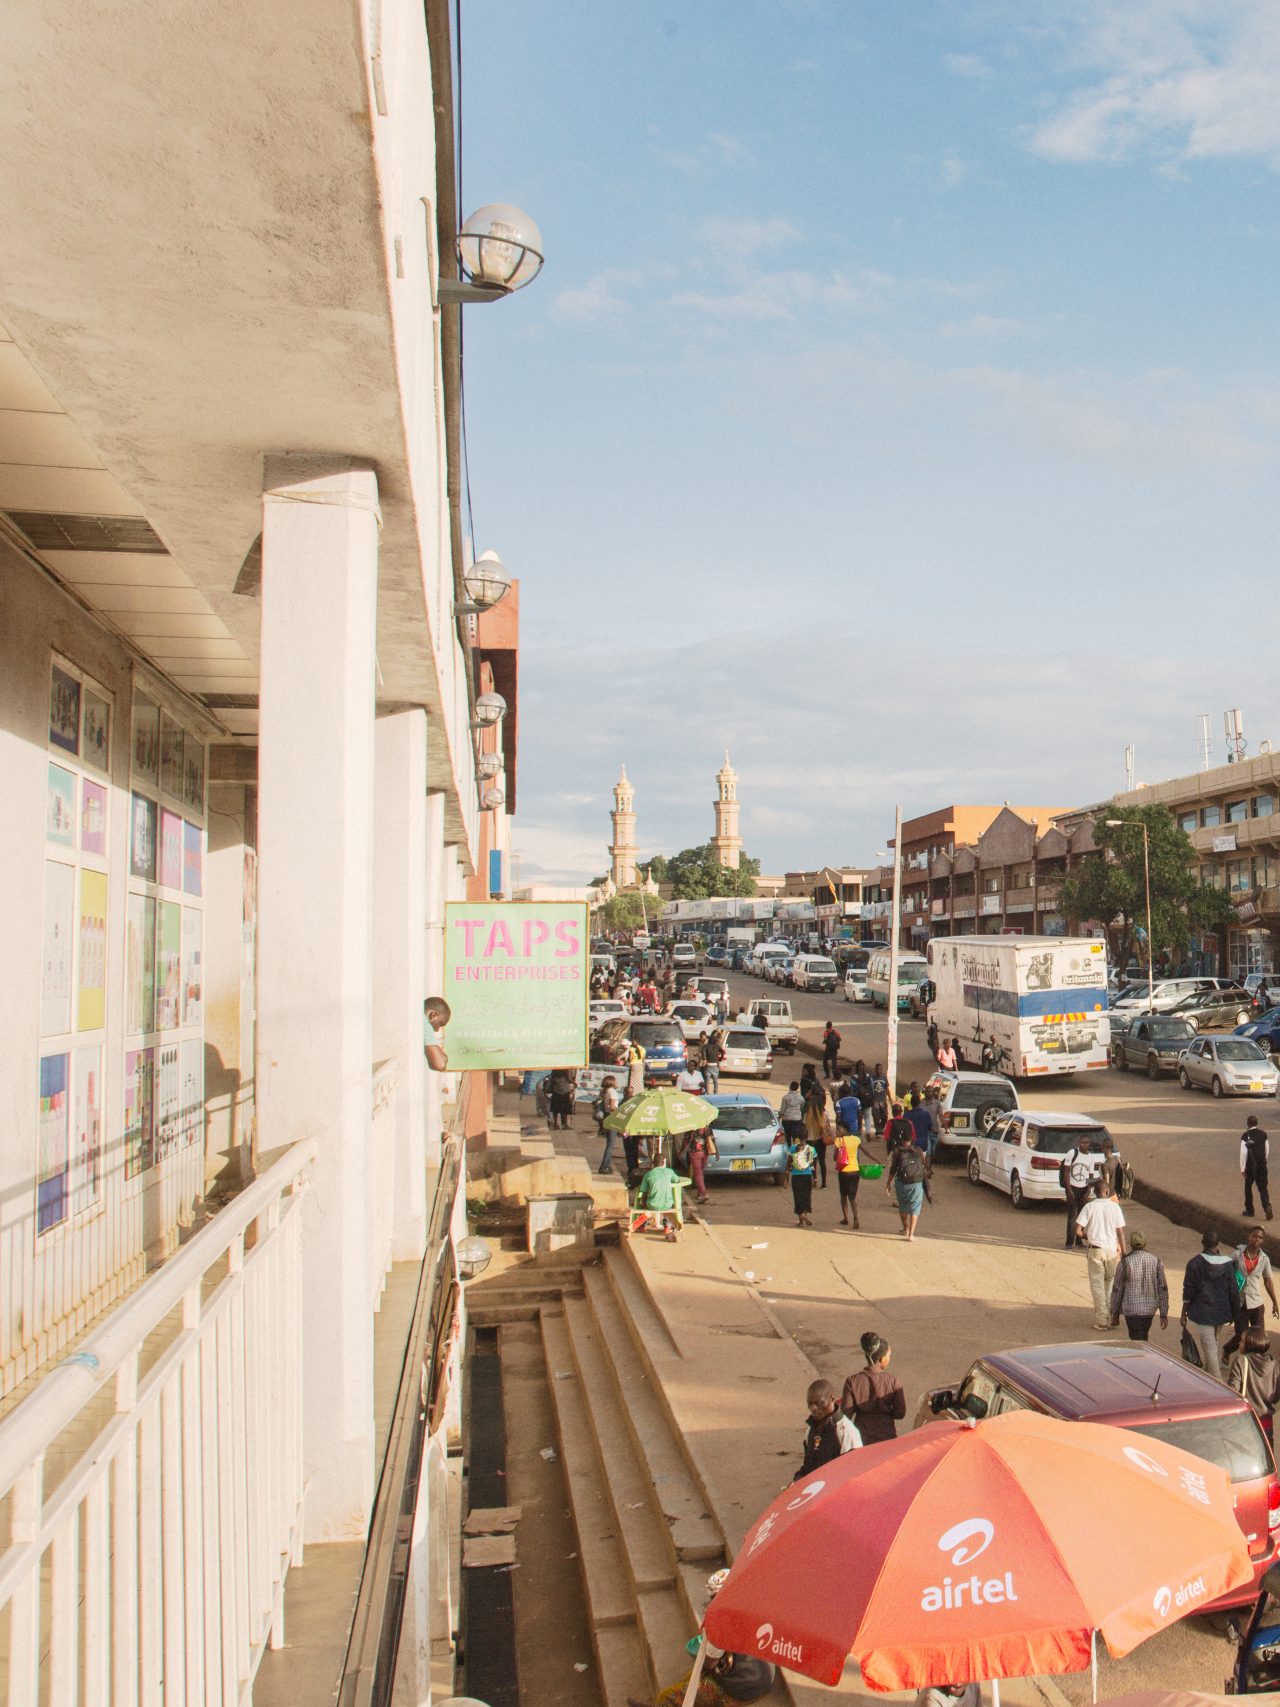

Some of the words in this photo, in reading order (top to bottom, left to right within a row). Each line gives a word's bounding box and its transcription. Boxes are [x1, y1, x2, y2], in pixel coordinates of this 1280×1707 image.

[455, 920, 580, 958] TAPS
[455, 965, 580, 981] ENTERPRISES
[1062, 974, 1103, 984] Britannia
[1178, 1465, 1211, 1505] airtel
[748, 1512, 779, 1556] airtel
[921, 1571, 1018, 1612] airtel
[1174, 1575, 1207, 1606] airtel
[771, 1635, 804, 1662] airtel
